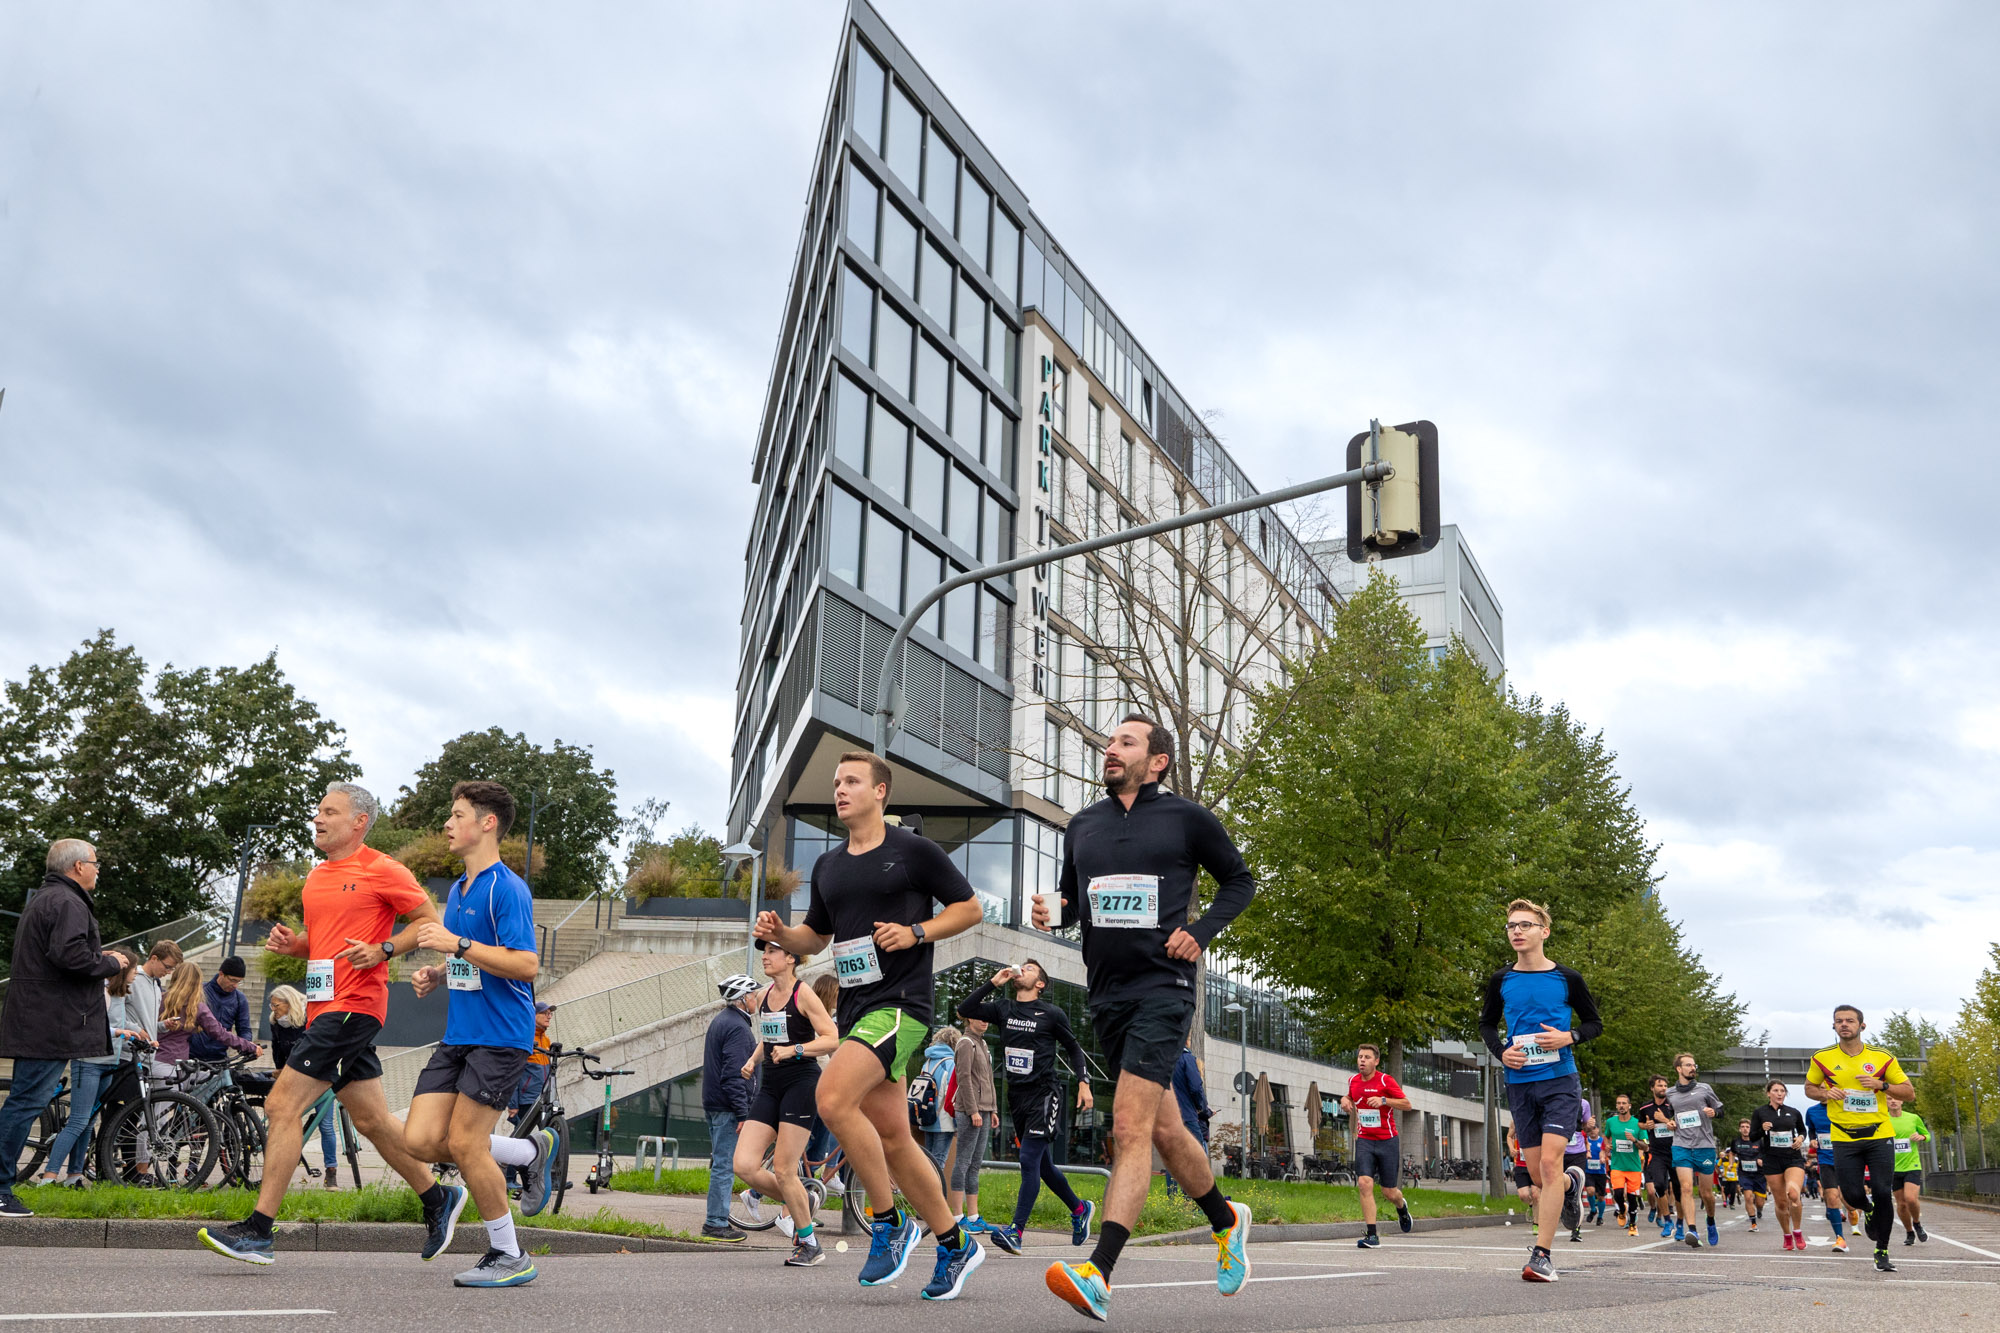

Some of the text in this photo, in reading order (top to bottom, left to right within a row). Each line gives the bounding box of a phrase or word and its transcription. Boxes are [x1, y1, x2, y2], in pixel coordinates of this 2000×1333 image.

[1039, 354, 1052, 493] PARK
[1102, 895, 1143, 911] 2772
[1105, 917, 1140, 925] Hieronymus
[451, 963, 470, 977] 2796
[838, 957, 866, 974] 2763
[847, 977, 863, 985] Adrian
[762, 1024, 779, 1034] 1817
[1011, 1057, 1025, 1067] 782
[1851, 1098, 1871, 1106] 2863
